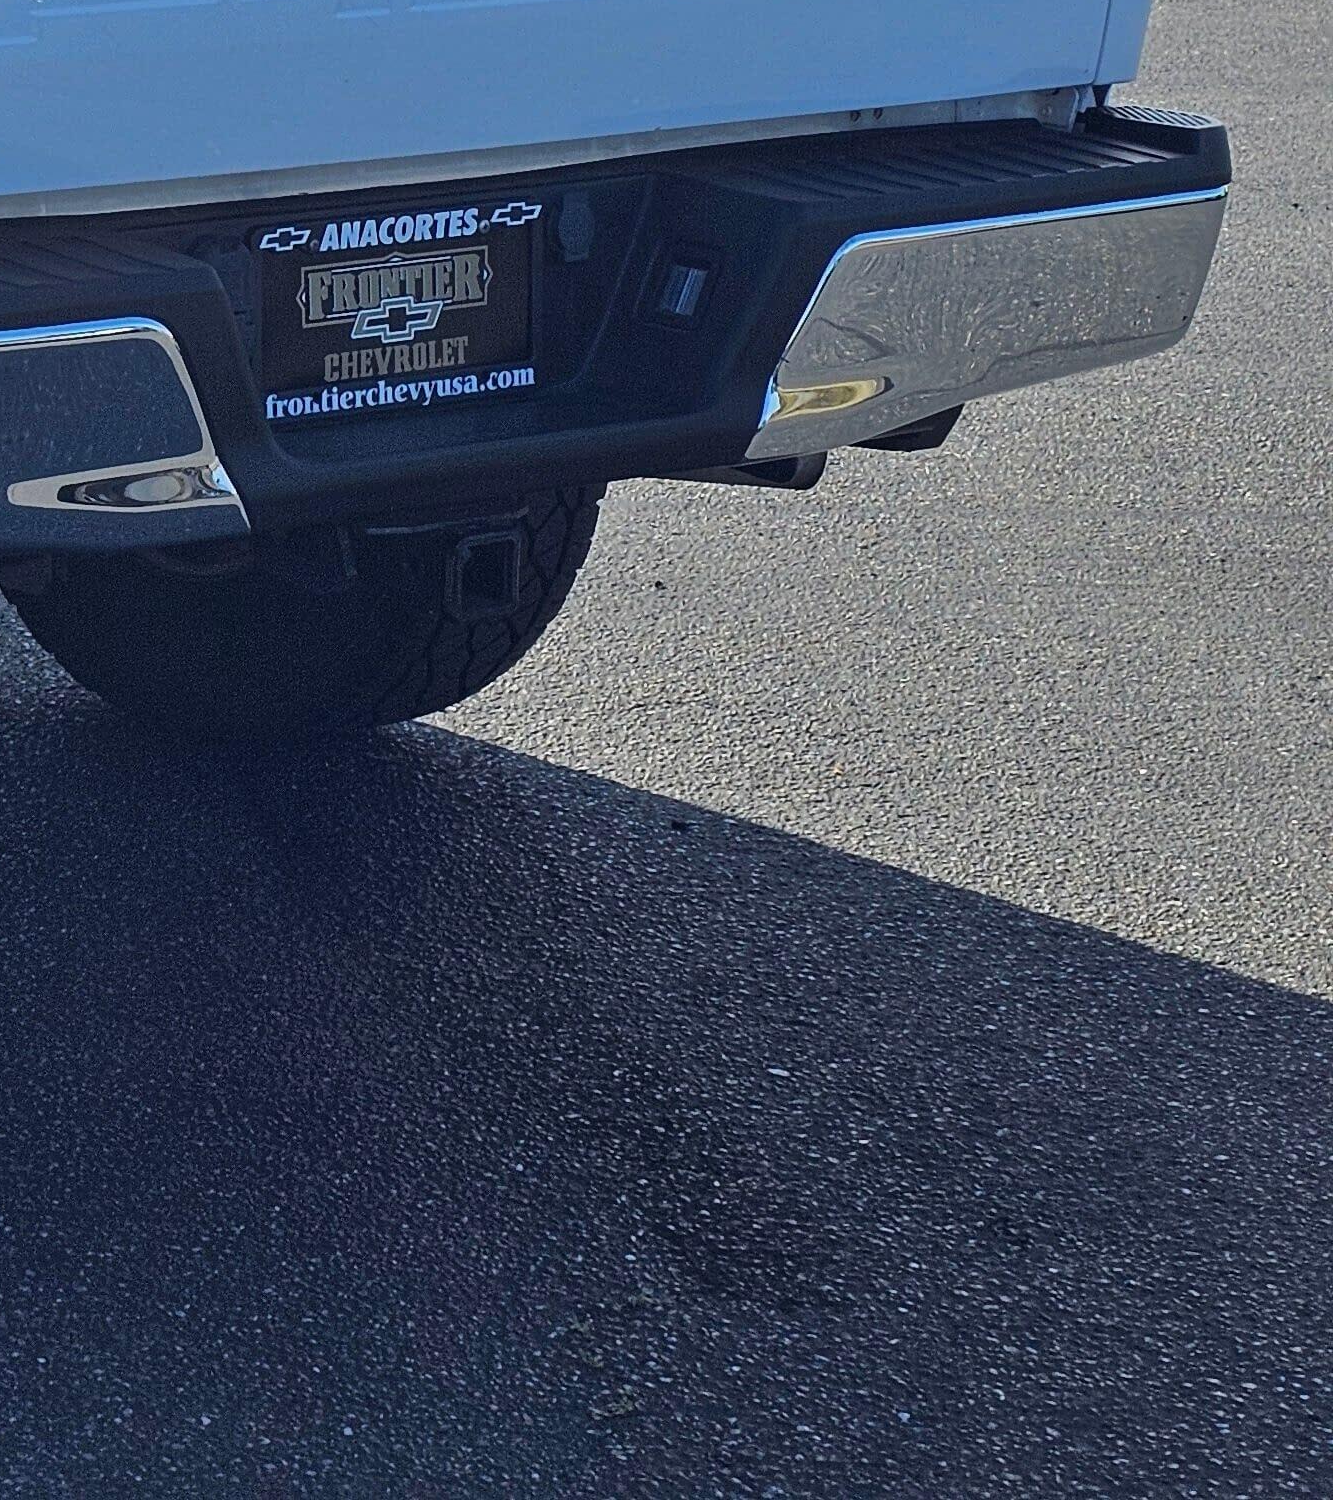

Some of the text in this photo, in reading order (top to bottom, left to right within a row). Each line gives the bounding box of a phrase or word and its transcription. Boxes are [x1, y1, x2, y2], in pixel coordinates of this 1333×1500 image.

[319, 208, 479, 252] ANACORTES
[307, 253, 484, 321] FRONTIER
[323, 336, 469, 383] CHEVROLET
